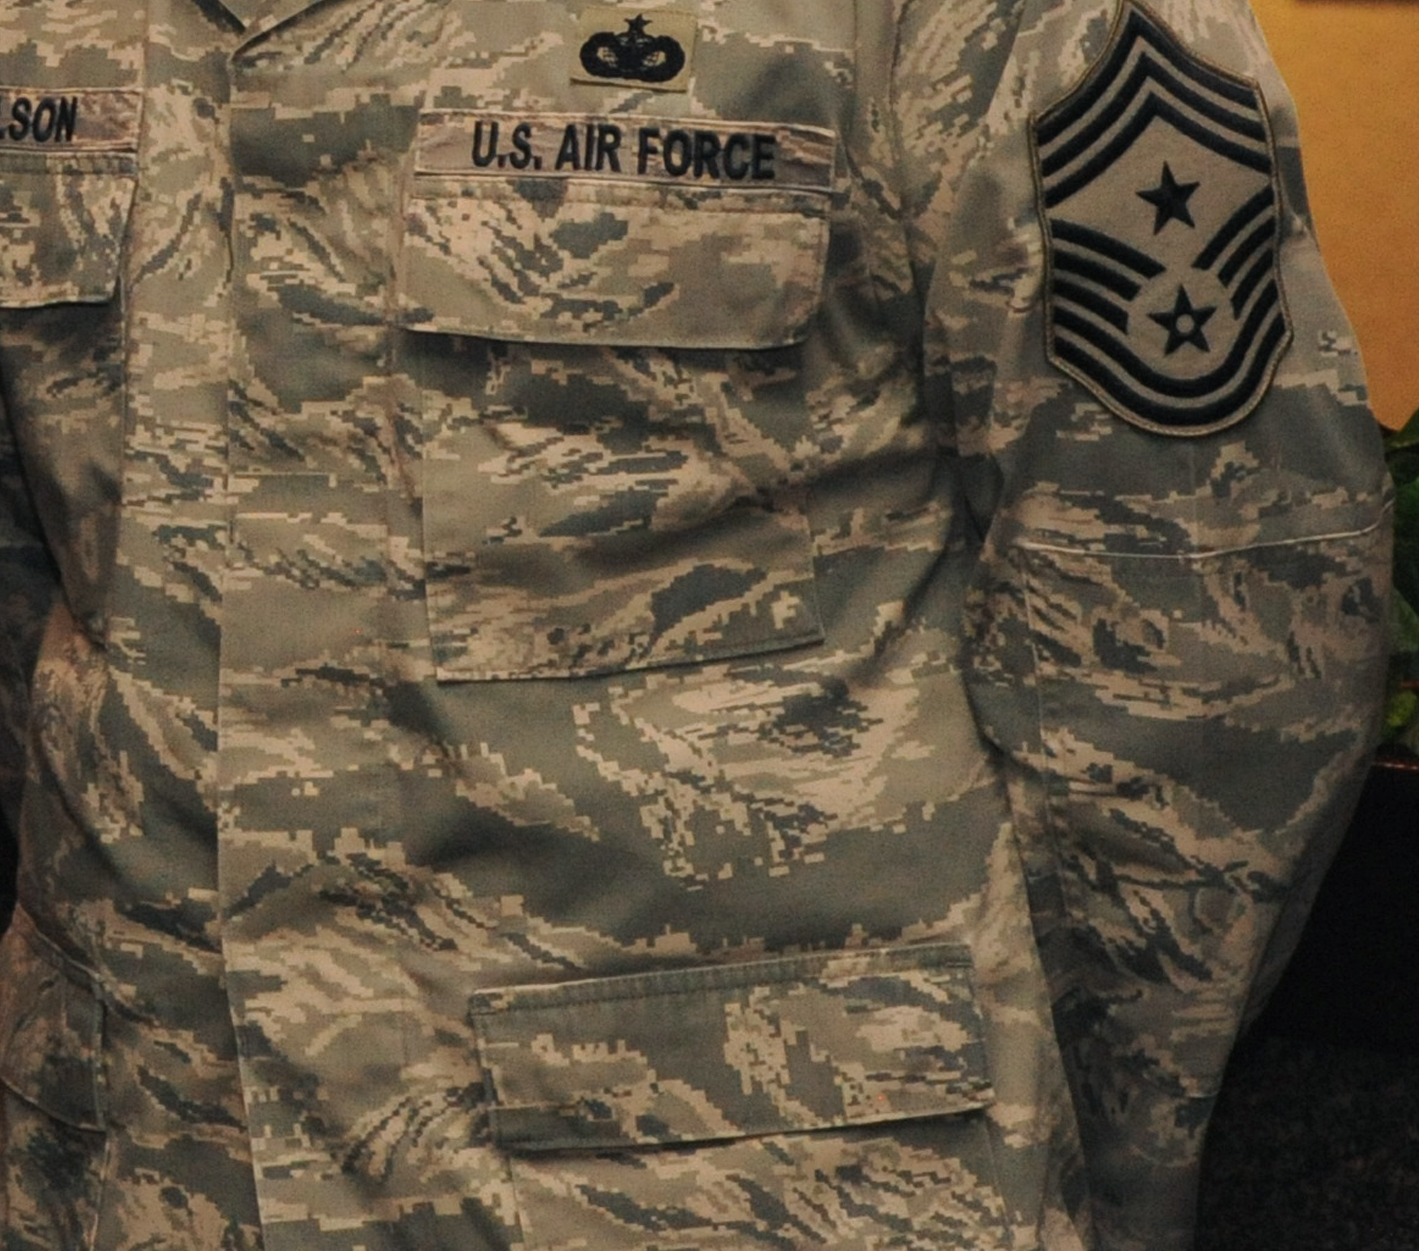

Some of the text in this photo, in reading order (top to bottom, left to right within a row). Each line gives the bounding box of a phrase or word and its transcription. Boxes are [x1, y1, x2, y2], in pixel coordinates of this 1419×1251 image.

[471, 120, 777, 181] U.S. AIR FORCE
